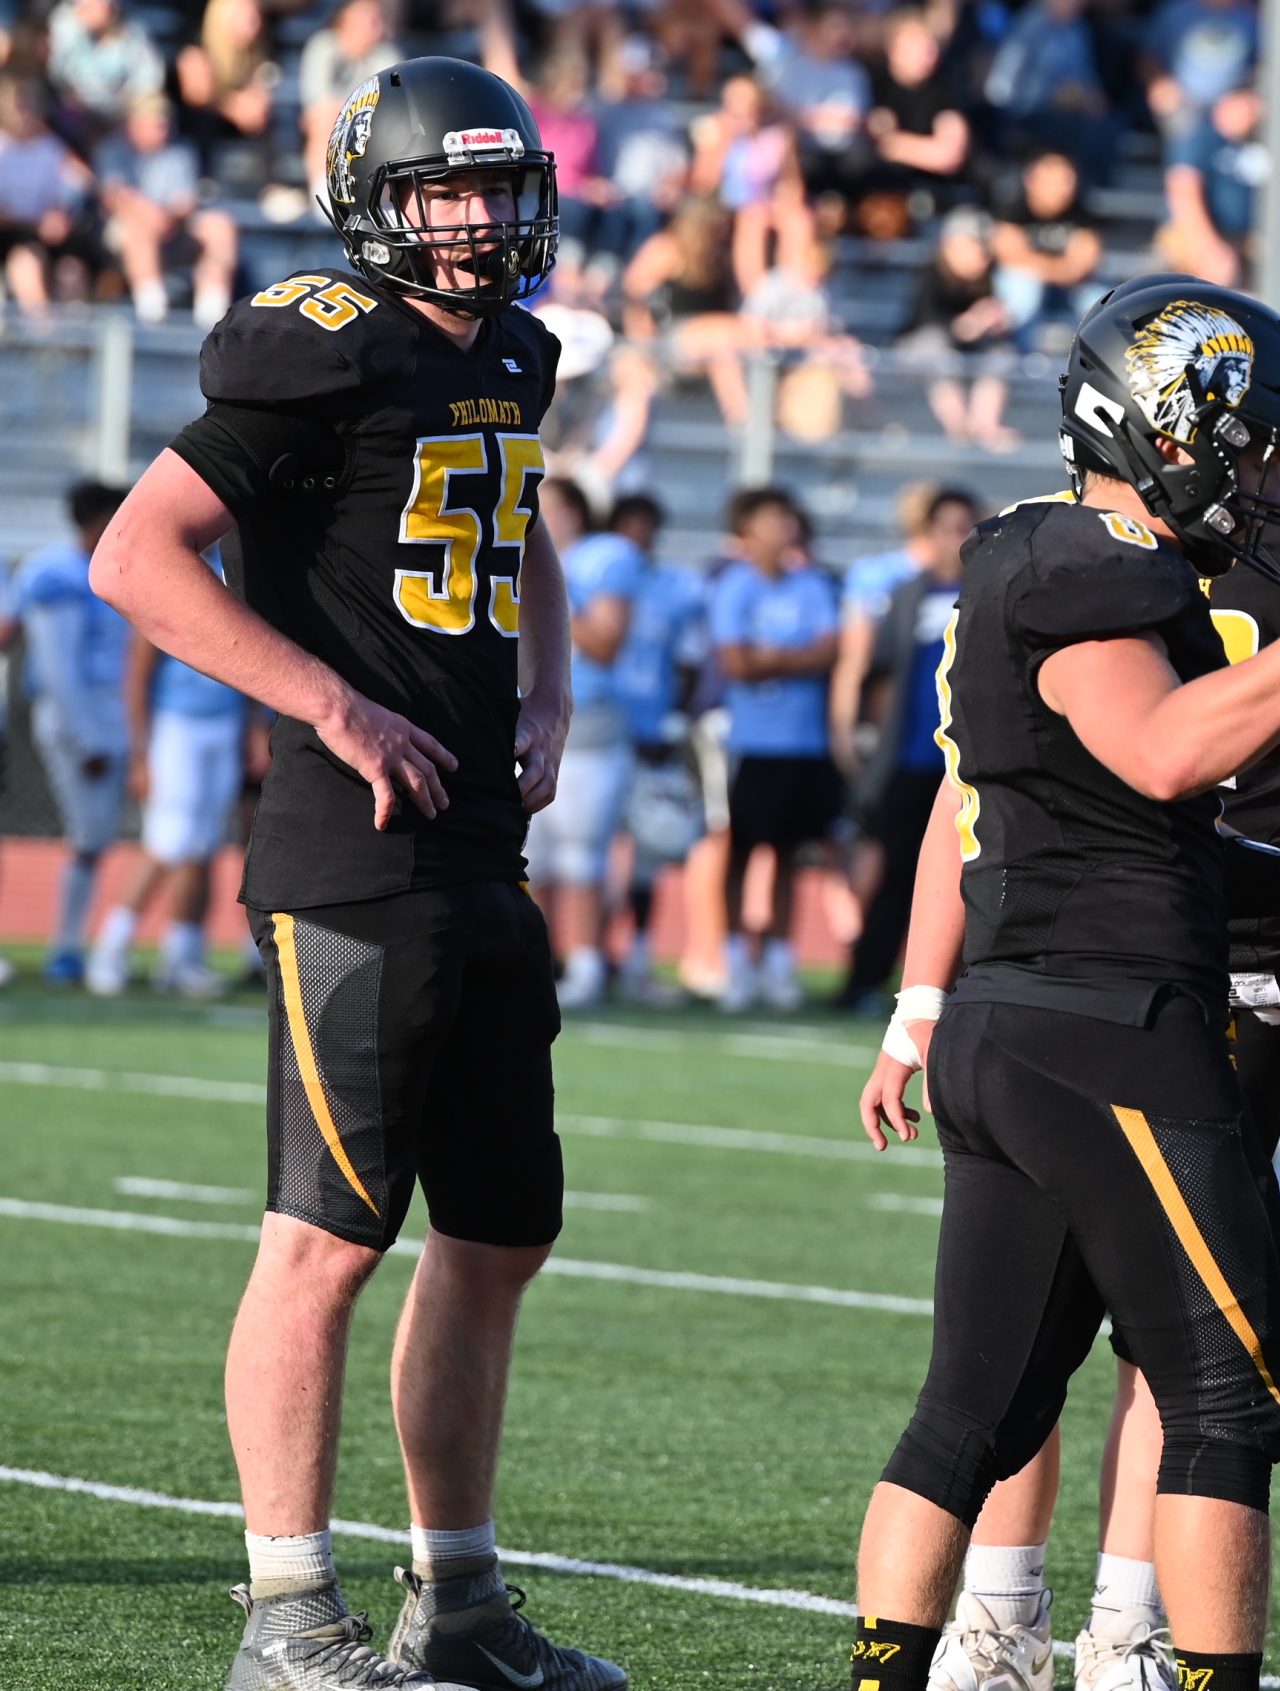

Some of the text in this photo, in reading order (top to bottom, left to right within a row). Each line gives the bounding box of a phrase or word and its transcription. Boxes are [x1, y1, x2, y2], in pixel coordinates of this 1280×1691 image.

[461, 132, 503, 145] Riddell
[250, 275, 379, 332] 55
[449, 398, 521, 427] PHILOMATH
[393, 432, 546, 638] 55
